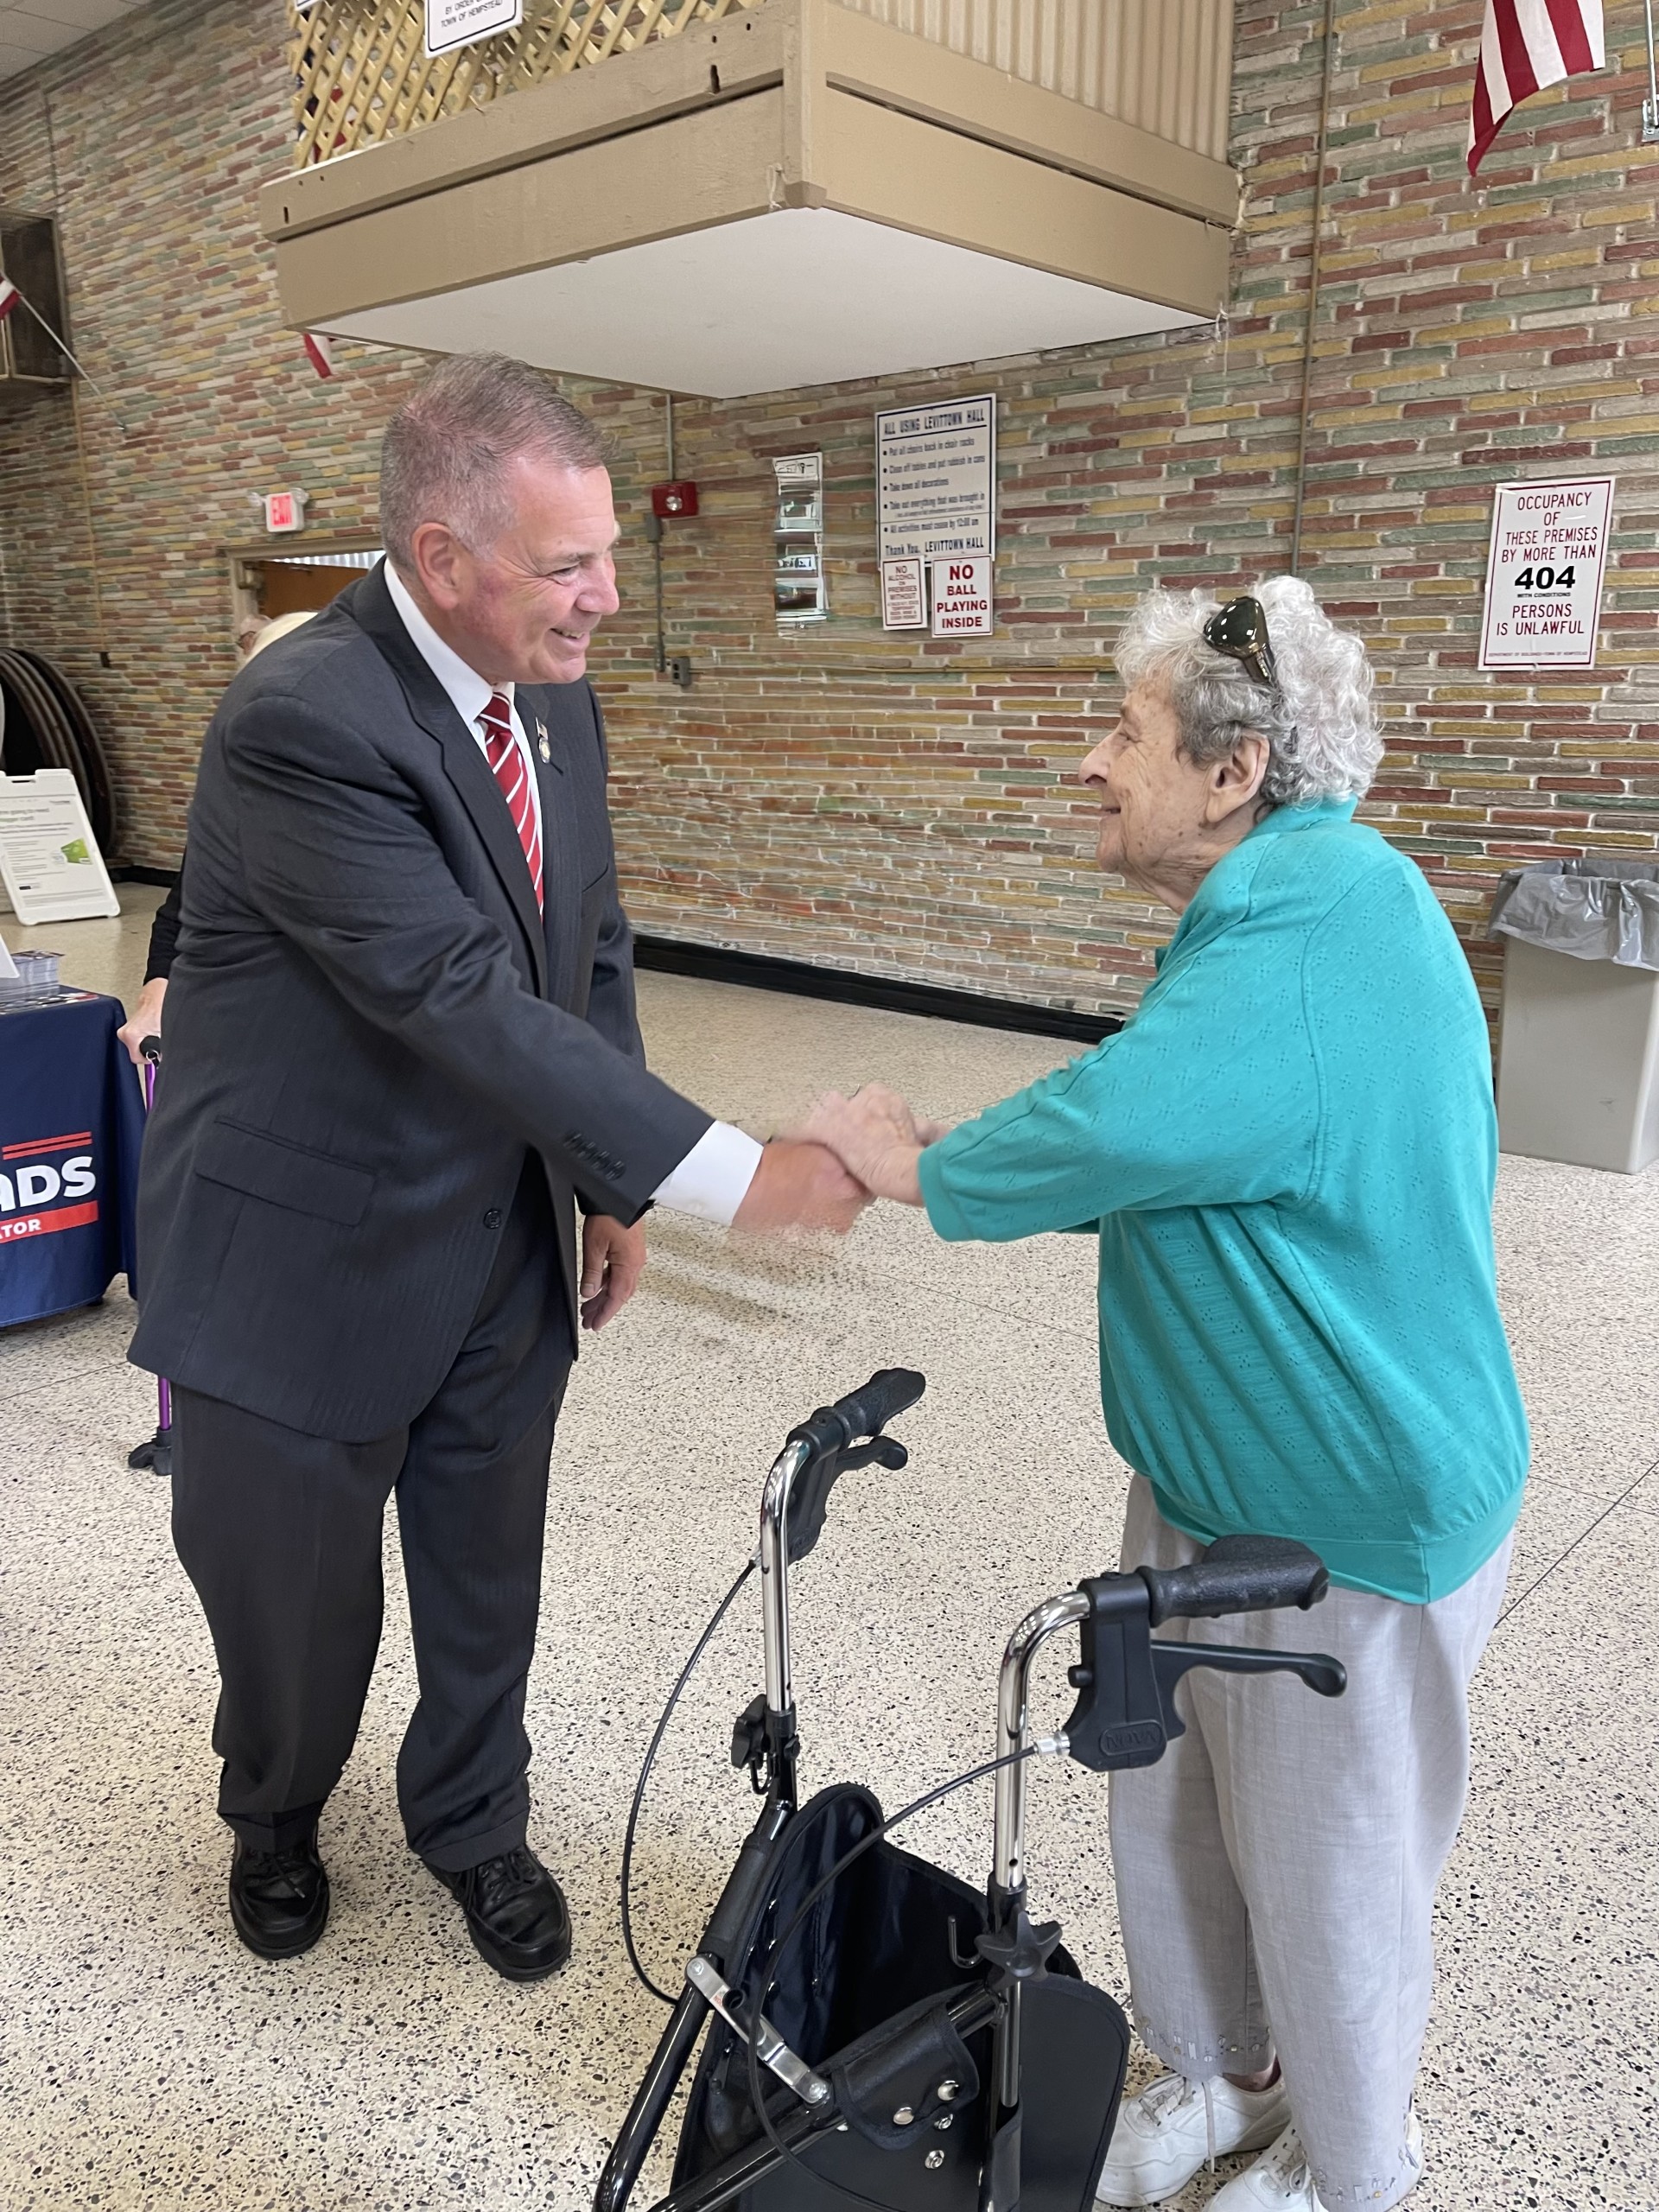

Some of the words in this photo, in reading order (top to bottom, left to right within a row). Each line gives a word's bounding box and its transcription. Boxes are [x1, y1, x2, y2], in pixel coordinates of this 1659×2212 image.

[441, 16, 456, 28] TOWN
[459, 12, 467, 21] OF
[884, 422, 895, 435] ALL
[899, 418, 920, 433] USING
[925, 412, 962, 429] LEVITTOWN
[967, 409, 984, 423] HALL
[1517, 492, 1592, 511] OCCUPANCY
[1543, 512, 1560, 526] OF
[1506, 530, 1539, 545] THESE
[1543, 526, 1598, 543] PREMISES
[885, 544, 904, 556] Thank
[925, 538, 963, 552] LEVITTOWN
[966, 537, 984, 549] HALL
[1502, 549, 1517, 563] BY
[1523, 546, 1556, 562] MORE
[1563, 544, 1597, 560] THAN
[888, 573, 916, 582] ALCOHOL
[895, 565, 907, 574] NO
[949, 564, 974, 581] NO
[1514, 565, 1576, 590] 404
[947, 584, 977, 596] BALL
[937, 600, 988, 613] PLAYING
[1512, 603, 1573, 619] PERSONS
[942, 616, 982, 628] INSIDE
[1497, 622, 1509, 636] IS
[1516, 620, 1585, 636] UNLAWFUL
[0, 1218, 41, 1240] TOR
